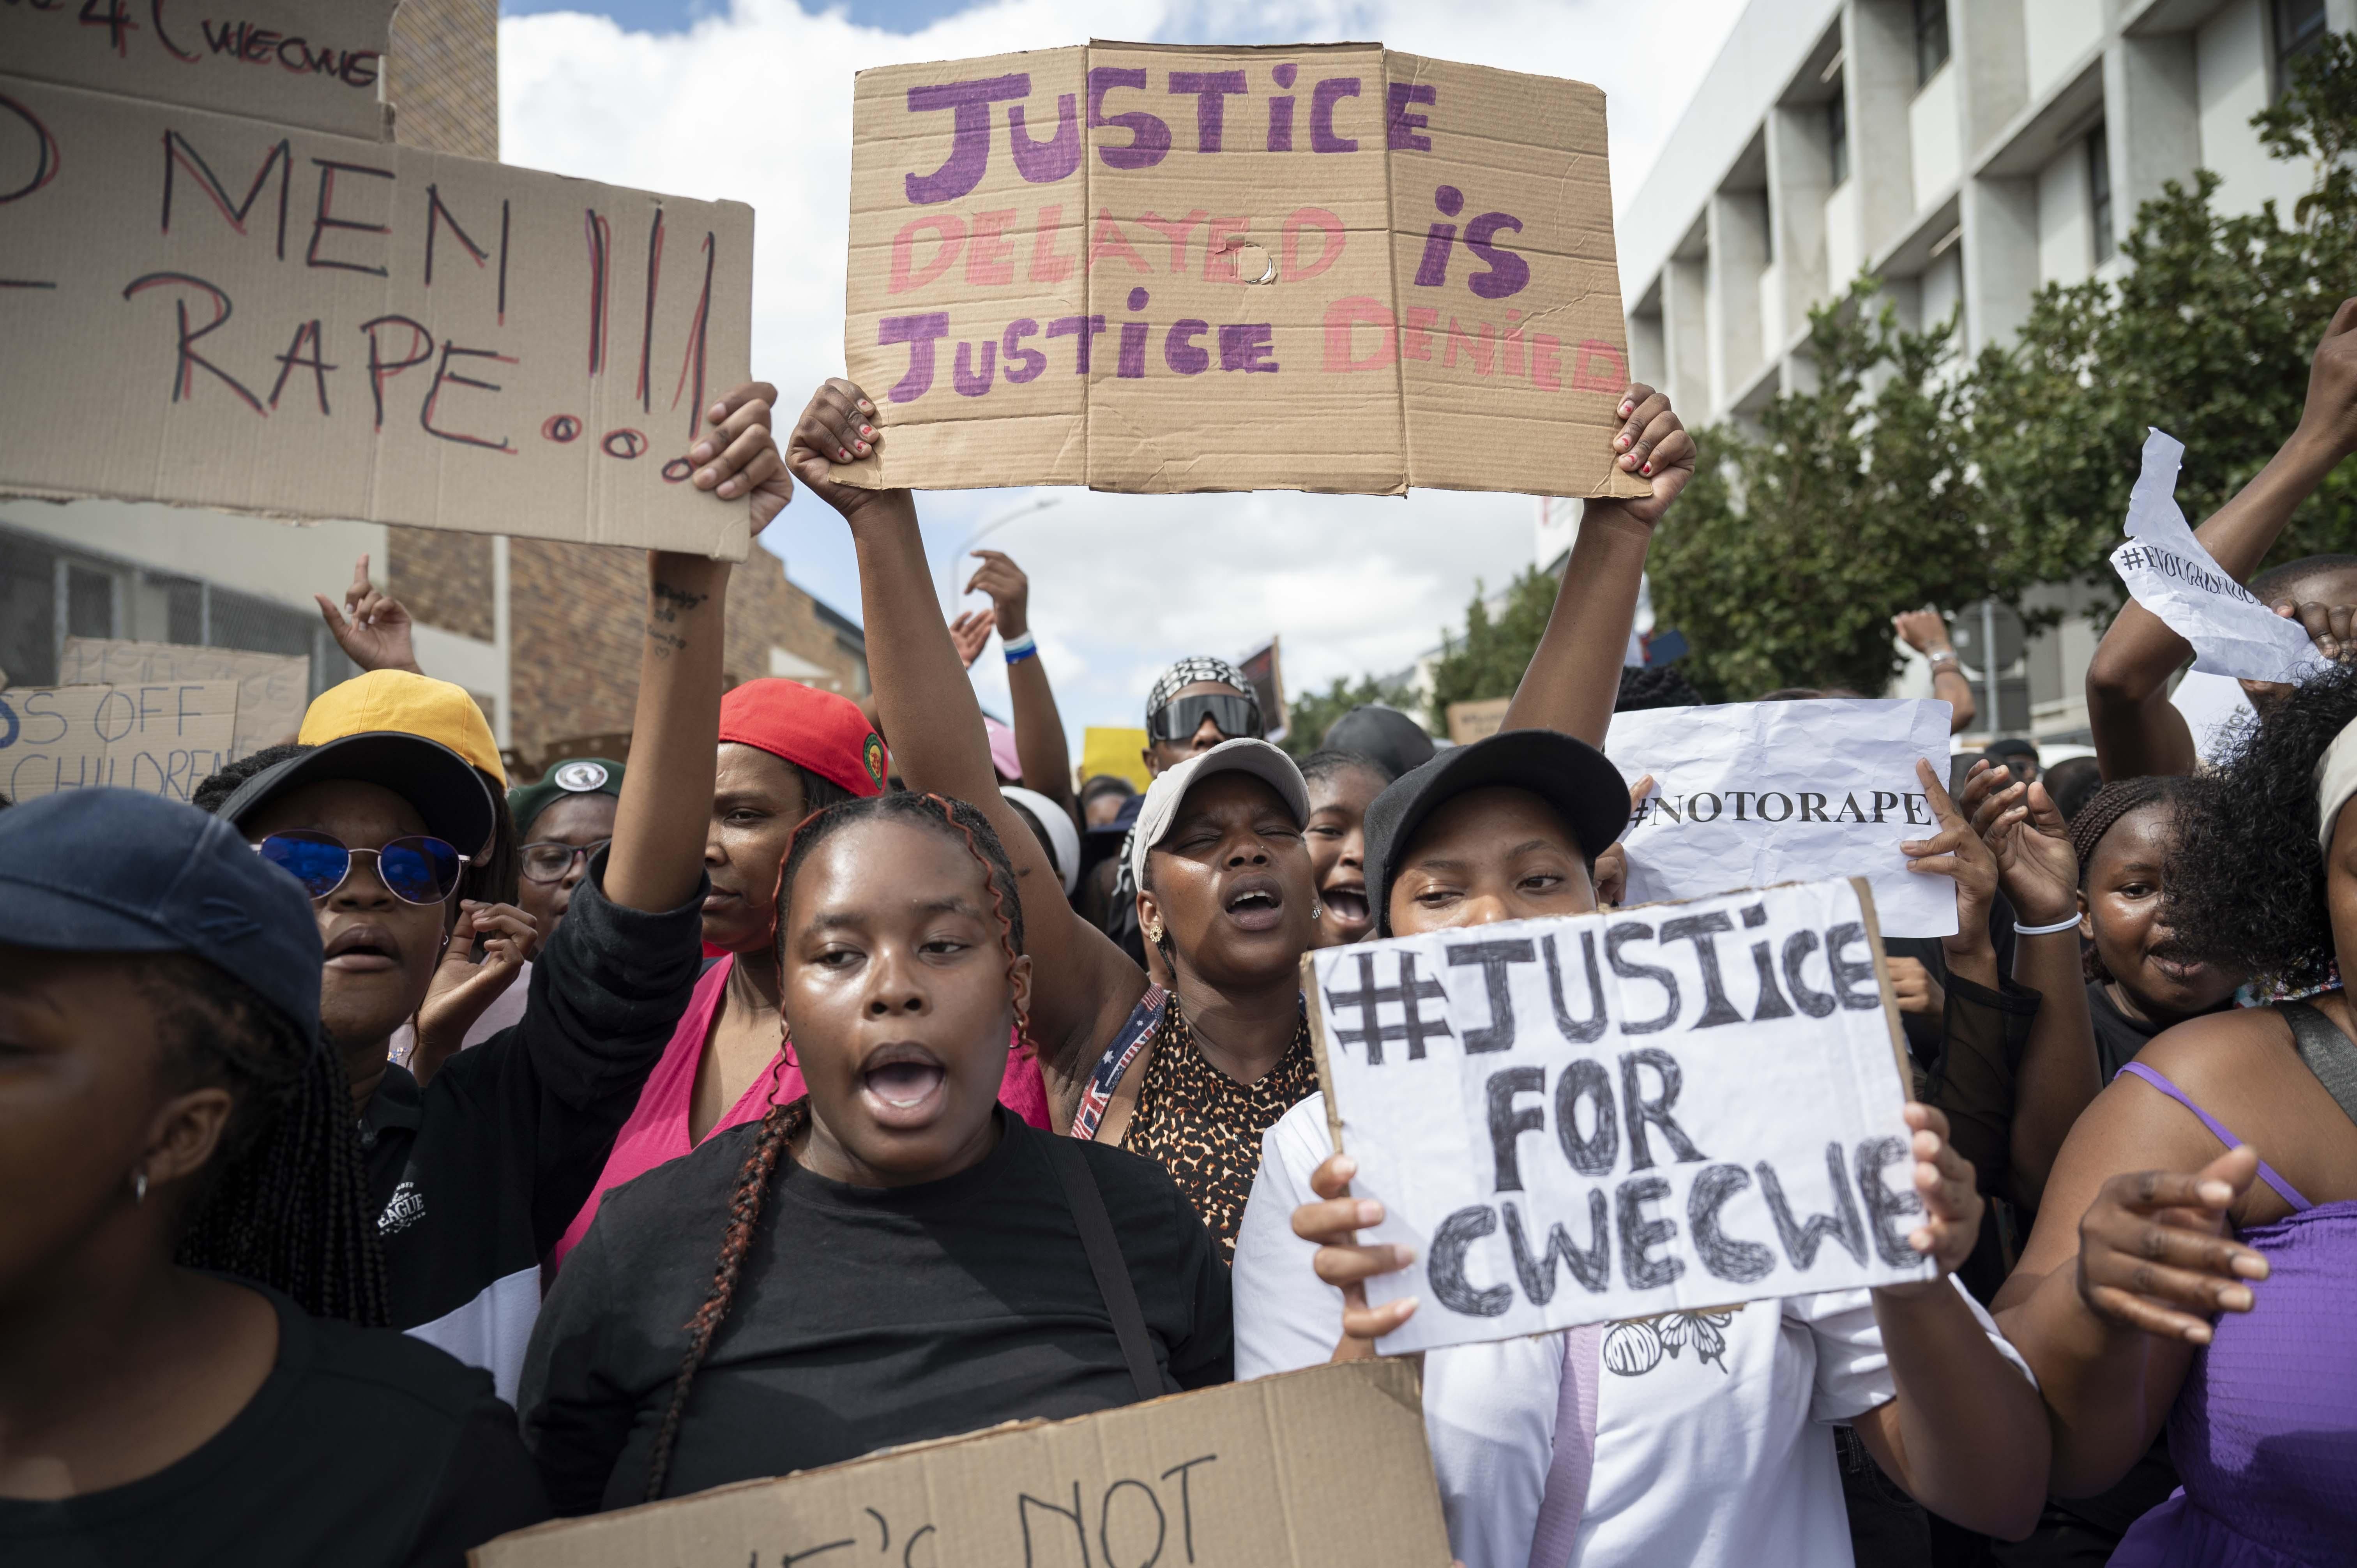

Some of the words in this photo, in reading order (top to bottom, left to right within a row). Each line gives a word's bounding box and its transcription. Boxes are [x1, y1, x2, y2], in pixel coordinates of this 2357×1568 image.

[79, 0, 139, 58] 4
[161, 128, 511, 327] MEN
[887, 205, 1346, 295] DELAYED
[94, 686, 204, 742] OFF
[1486, 1048, 1709, 1192] FOR
[1428, 1136, 1925, 1317] CWECWE
[1019, 1454, 1217, 1568] NOT
